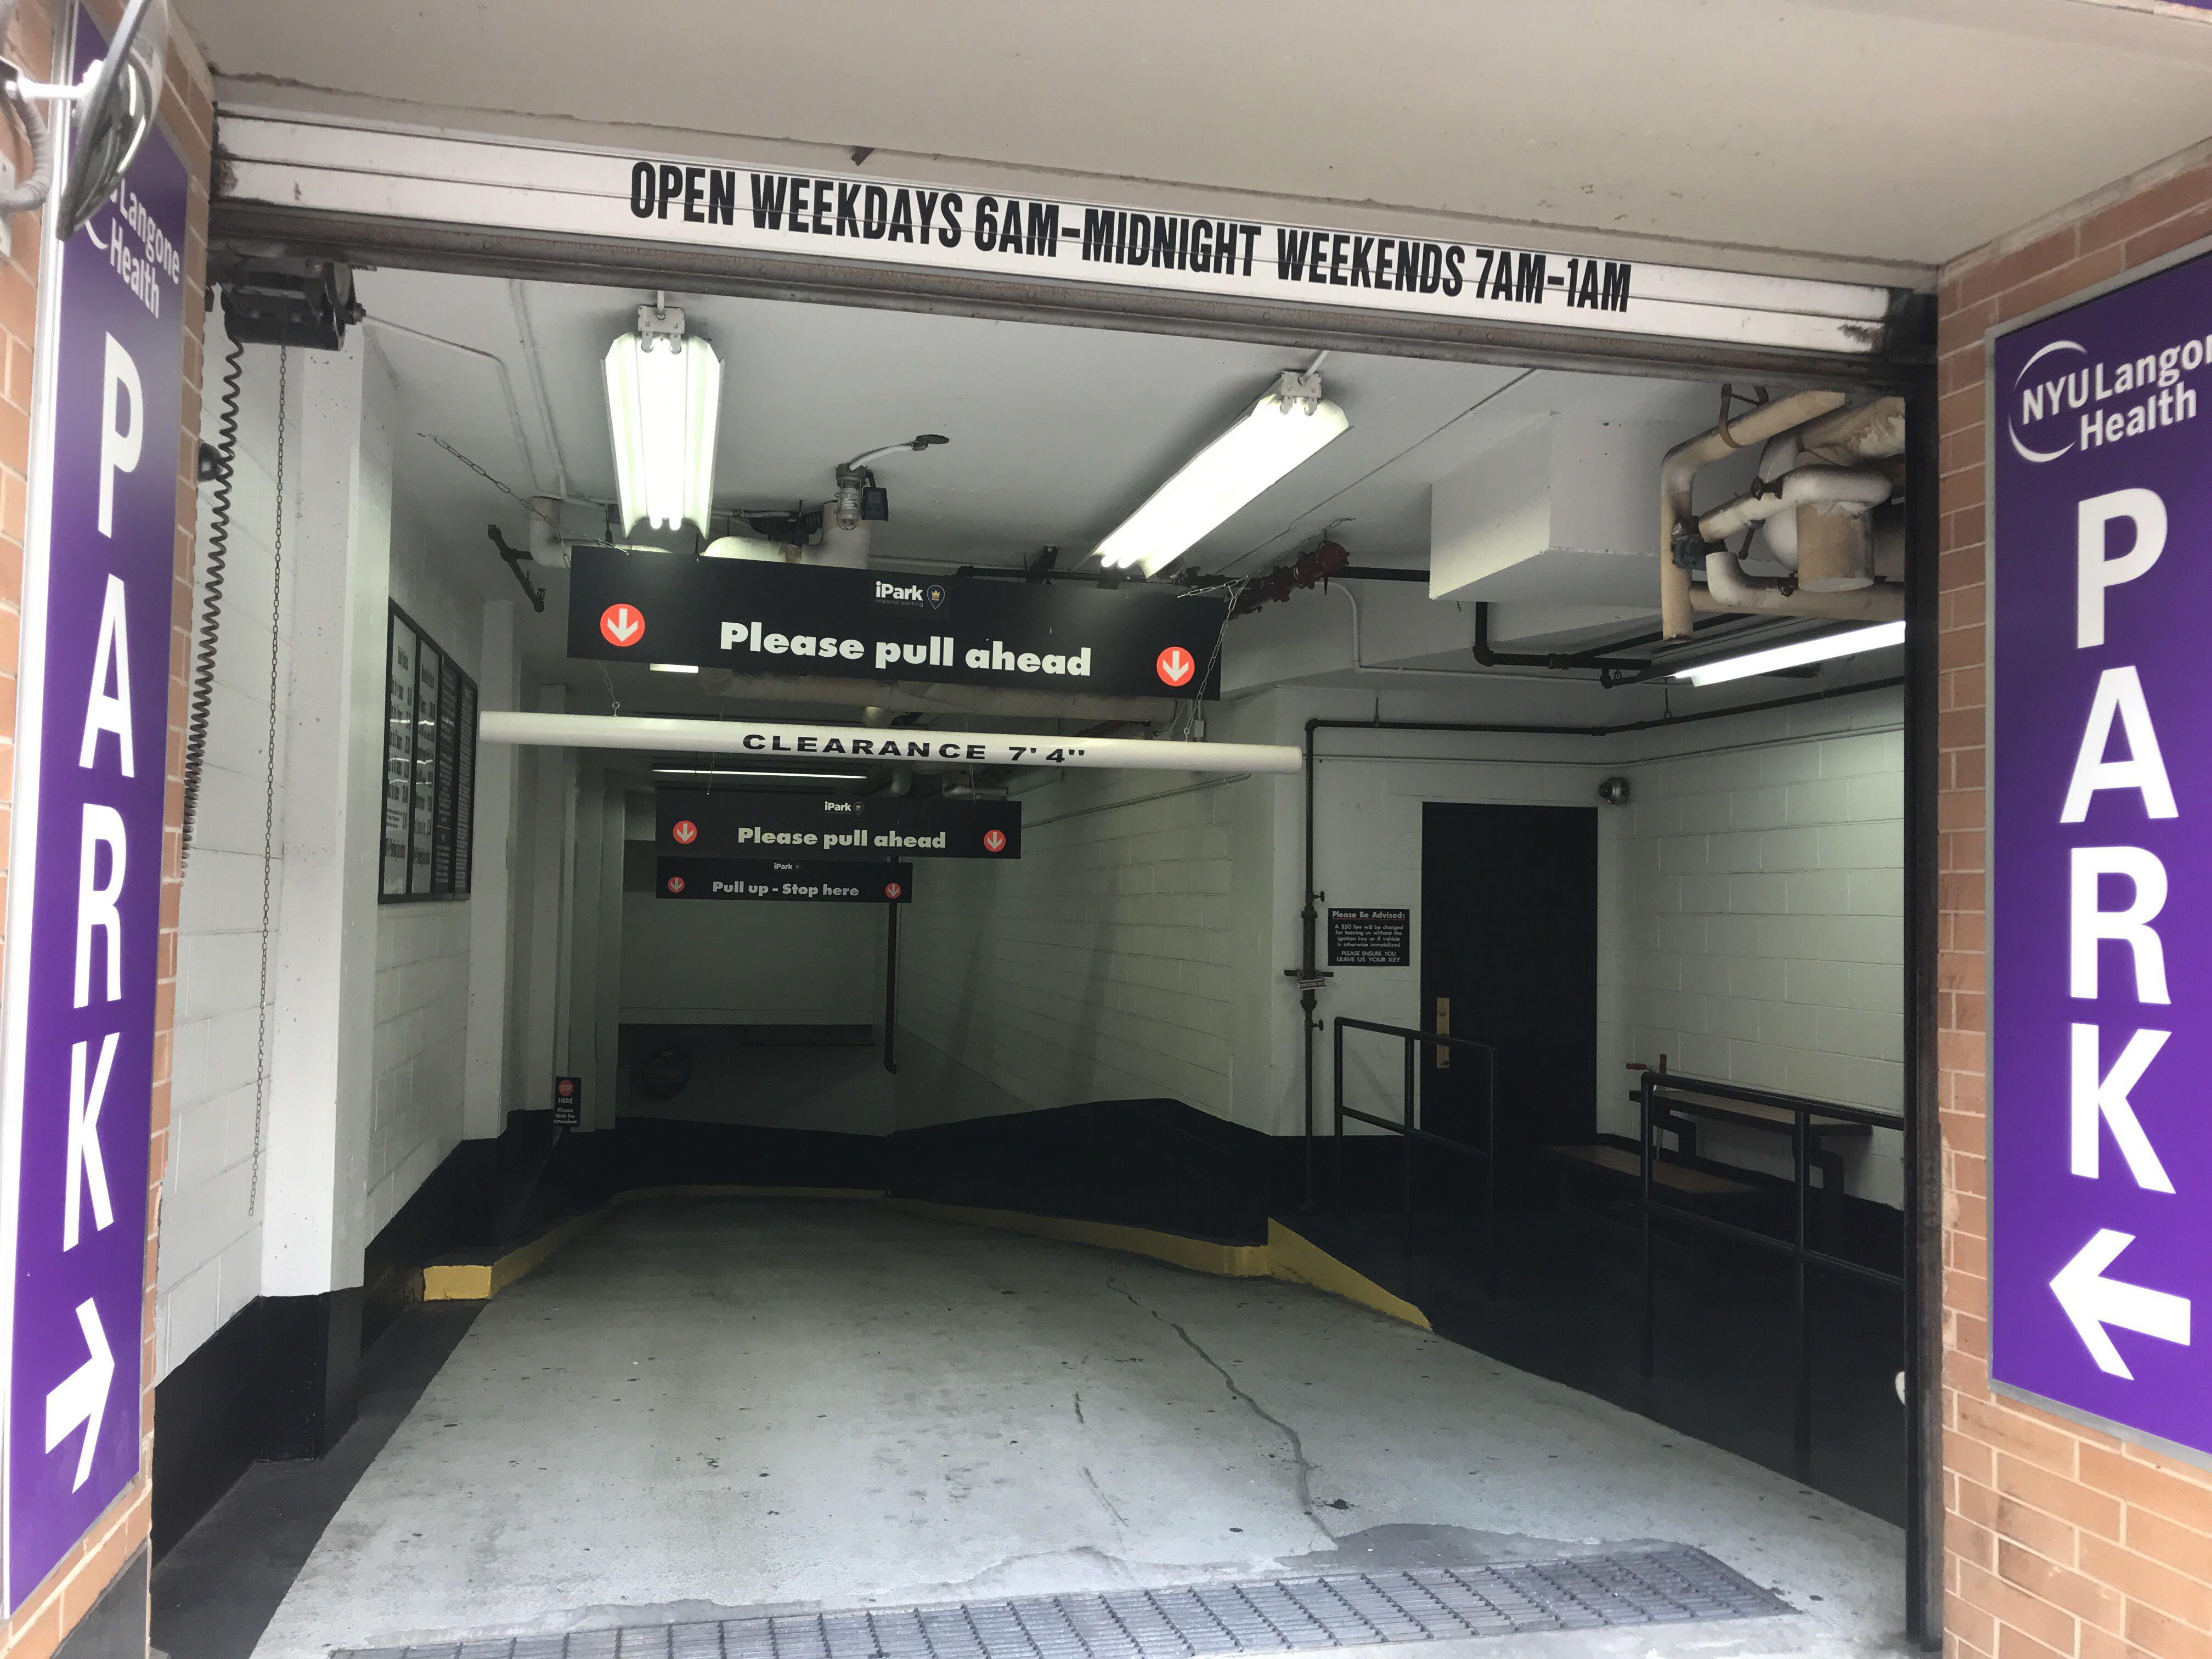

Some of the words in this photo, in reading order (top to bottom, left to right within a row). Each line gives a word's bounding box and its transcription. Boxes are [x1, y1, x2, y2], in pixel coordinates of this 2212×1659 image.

[120, 178, 180, 284] Langone
[630, 161, 735, 225] OPEN
[751, 173, 962, 248] WEEKDAYS
[1277, 228, 1465, 297] WEEKENDS
[110, 217, 159, 319] Health
[2022, 368, 2089, 425] NYU
[2080, 380, 2197, 451] Health
[876, 580, 923, 601] iPark
[720, 622, 865, 659] Please
[876, 636, 953, 669] pull
[966, 641, 1092, 676] ahead
[742, 734, 986, 761] CLEARANCE
[63, 331, 144, 1251] PARK
[825, 801, 851, 811] iPark
[738, 827, 817, 845] Please
[823, 830, 868, 849] pull
[873, 831, 946, 848] ahead
[2059, 488, 2179, 1194] PARK
[713, 881, 744, 893] Pull
[748, 885, 769, 896] up
[782, 883, 819, 898] Stop
[823, 884, 860, 896] here
